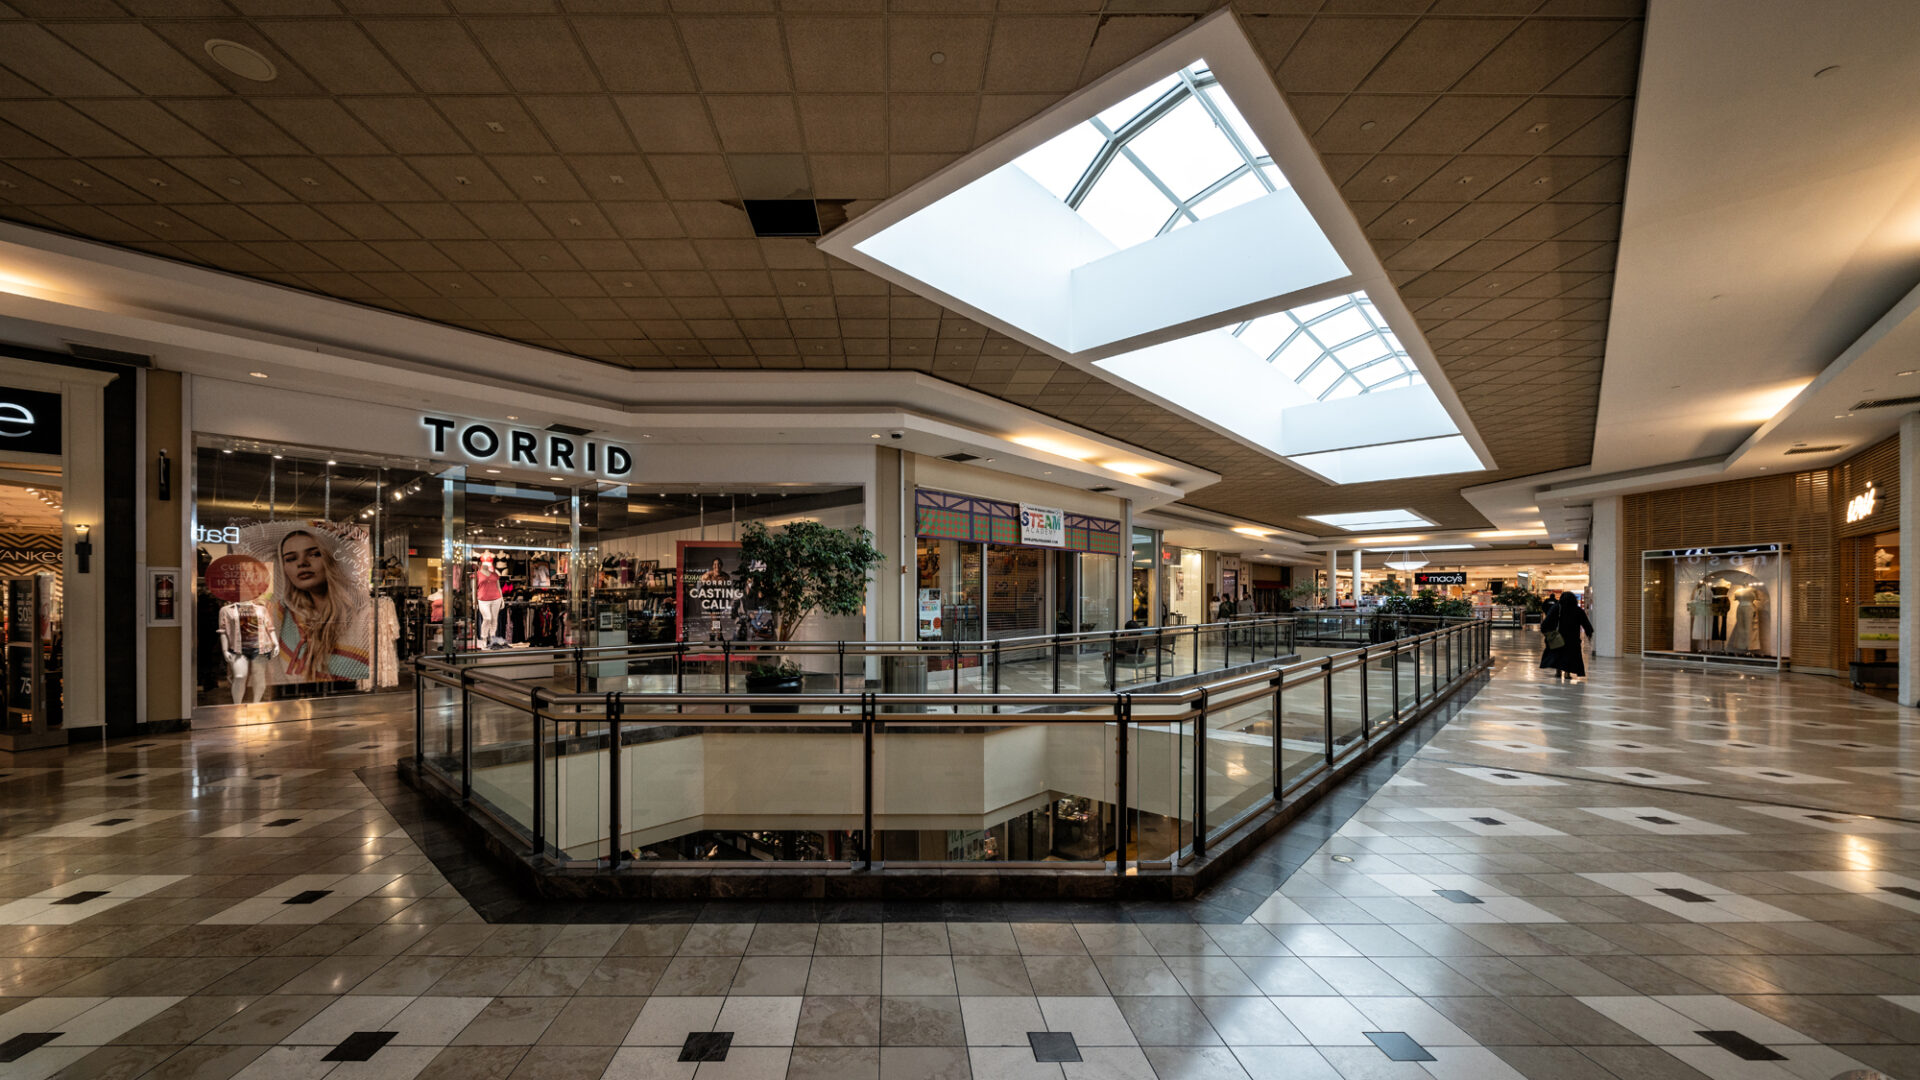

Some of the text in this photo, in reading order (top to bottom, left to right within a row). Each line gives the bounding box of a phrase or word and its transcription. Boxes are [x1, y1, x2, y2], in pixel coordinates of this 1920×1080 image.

[424, 417, 633, 475] TORRID
[1021, 511, 1061, 530] STEAM
[1026, 527, 1057, 535] ACADEMY
[1428, 573, 1463, 584] macy's
[689, 588, 744, 599] CASTING
[701, 599, 732, 610] CALL
